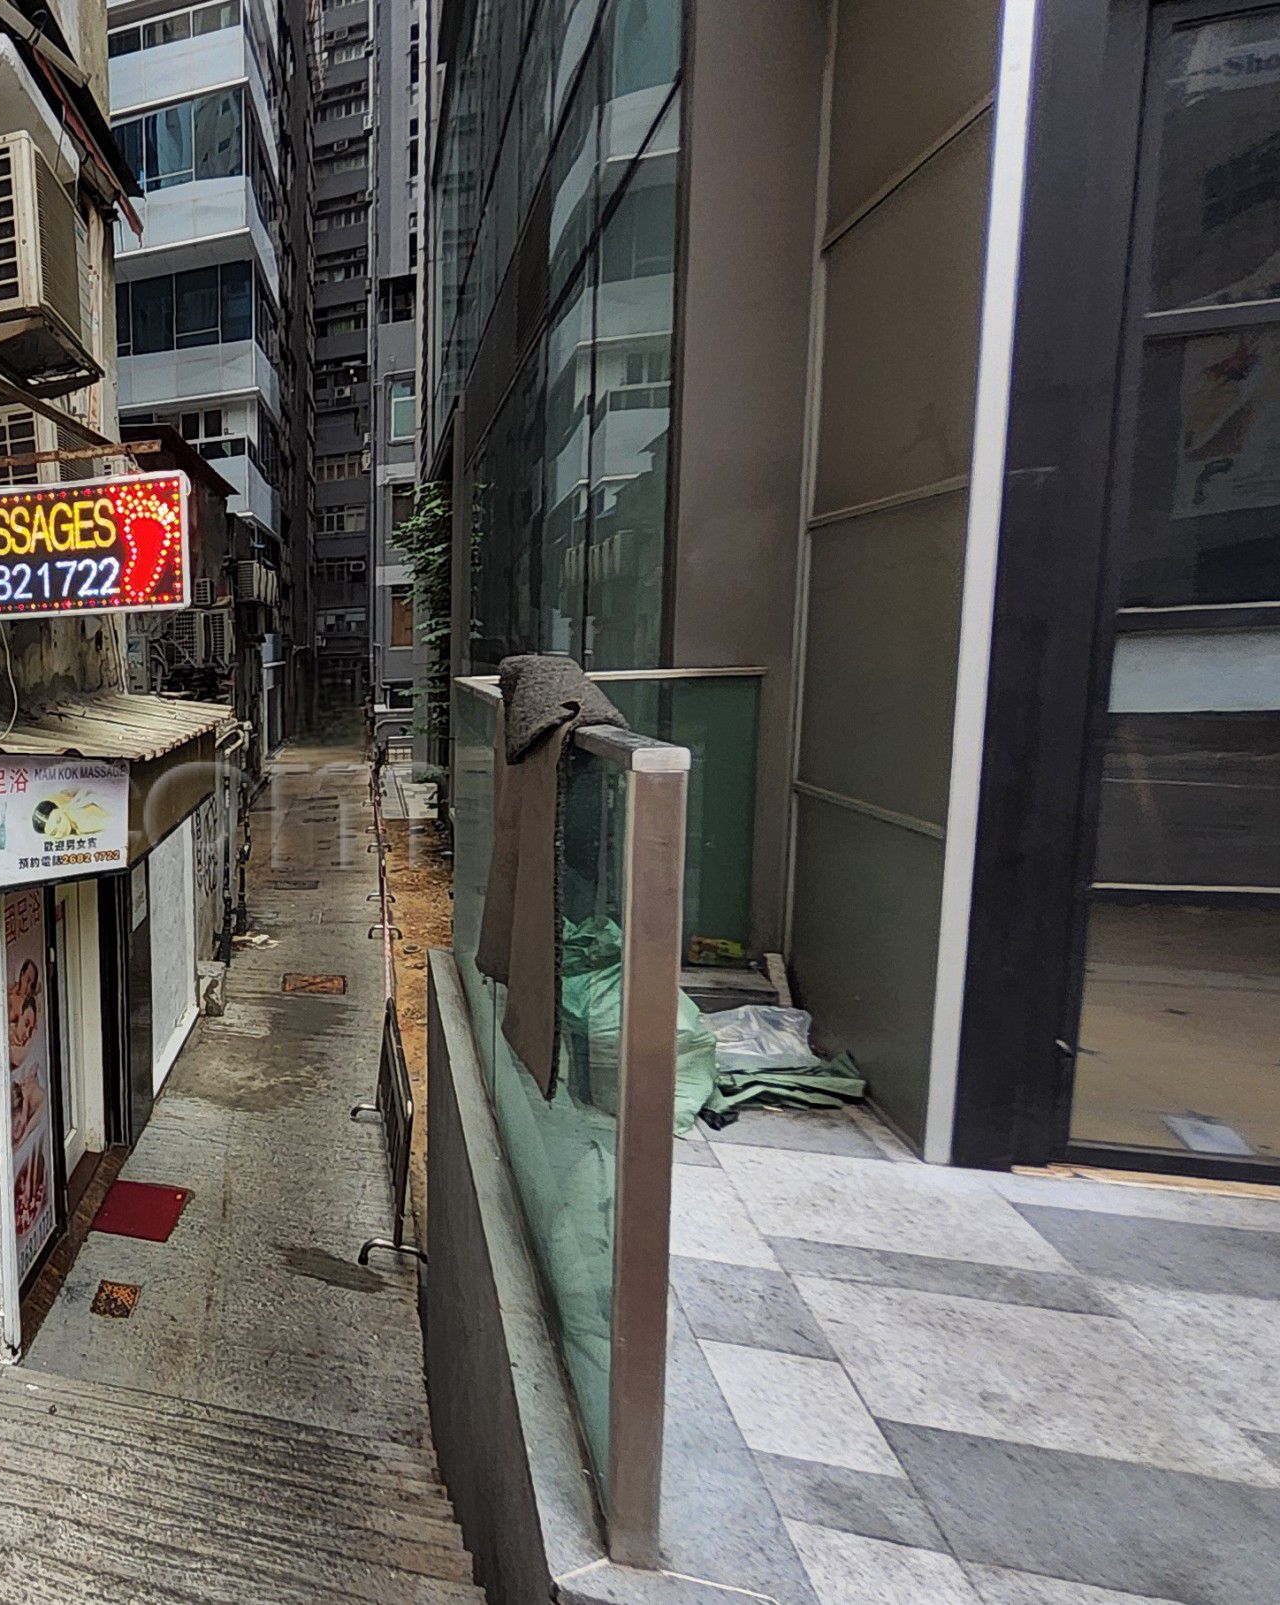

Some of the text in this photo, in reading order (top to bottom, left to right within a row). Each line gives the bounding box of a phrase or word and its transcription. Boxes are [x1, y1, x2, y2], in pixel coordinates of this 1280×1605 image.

[58, 766, 80, 780] KOK
[80, 761, 126, 780] MASSAGE
[93, 849, 121, 862] 1722
